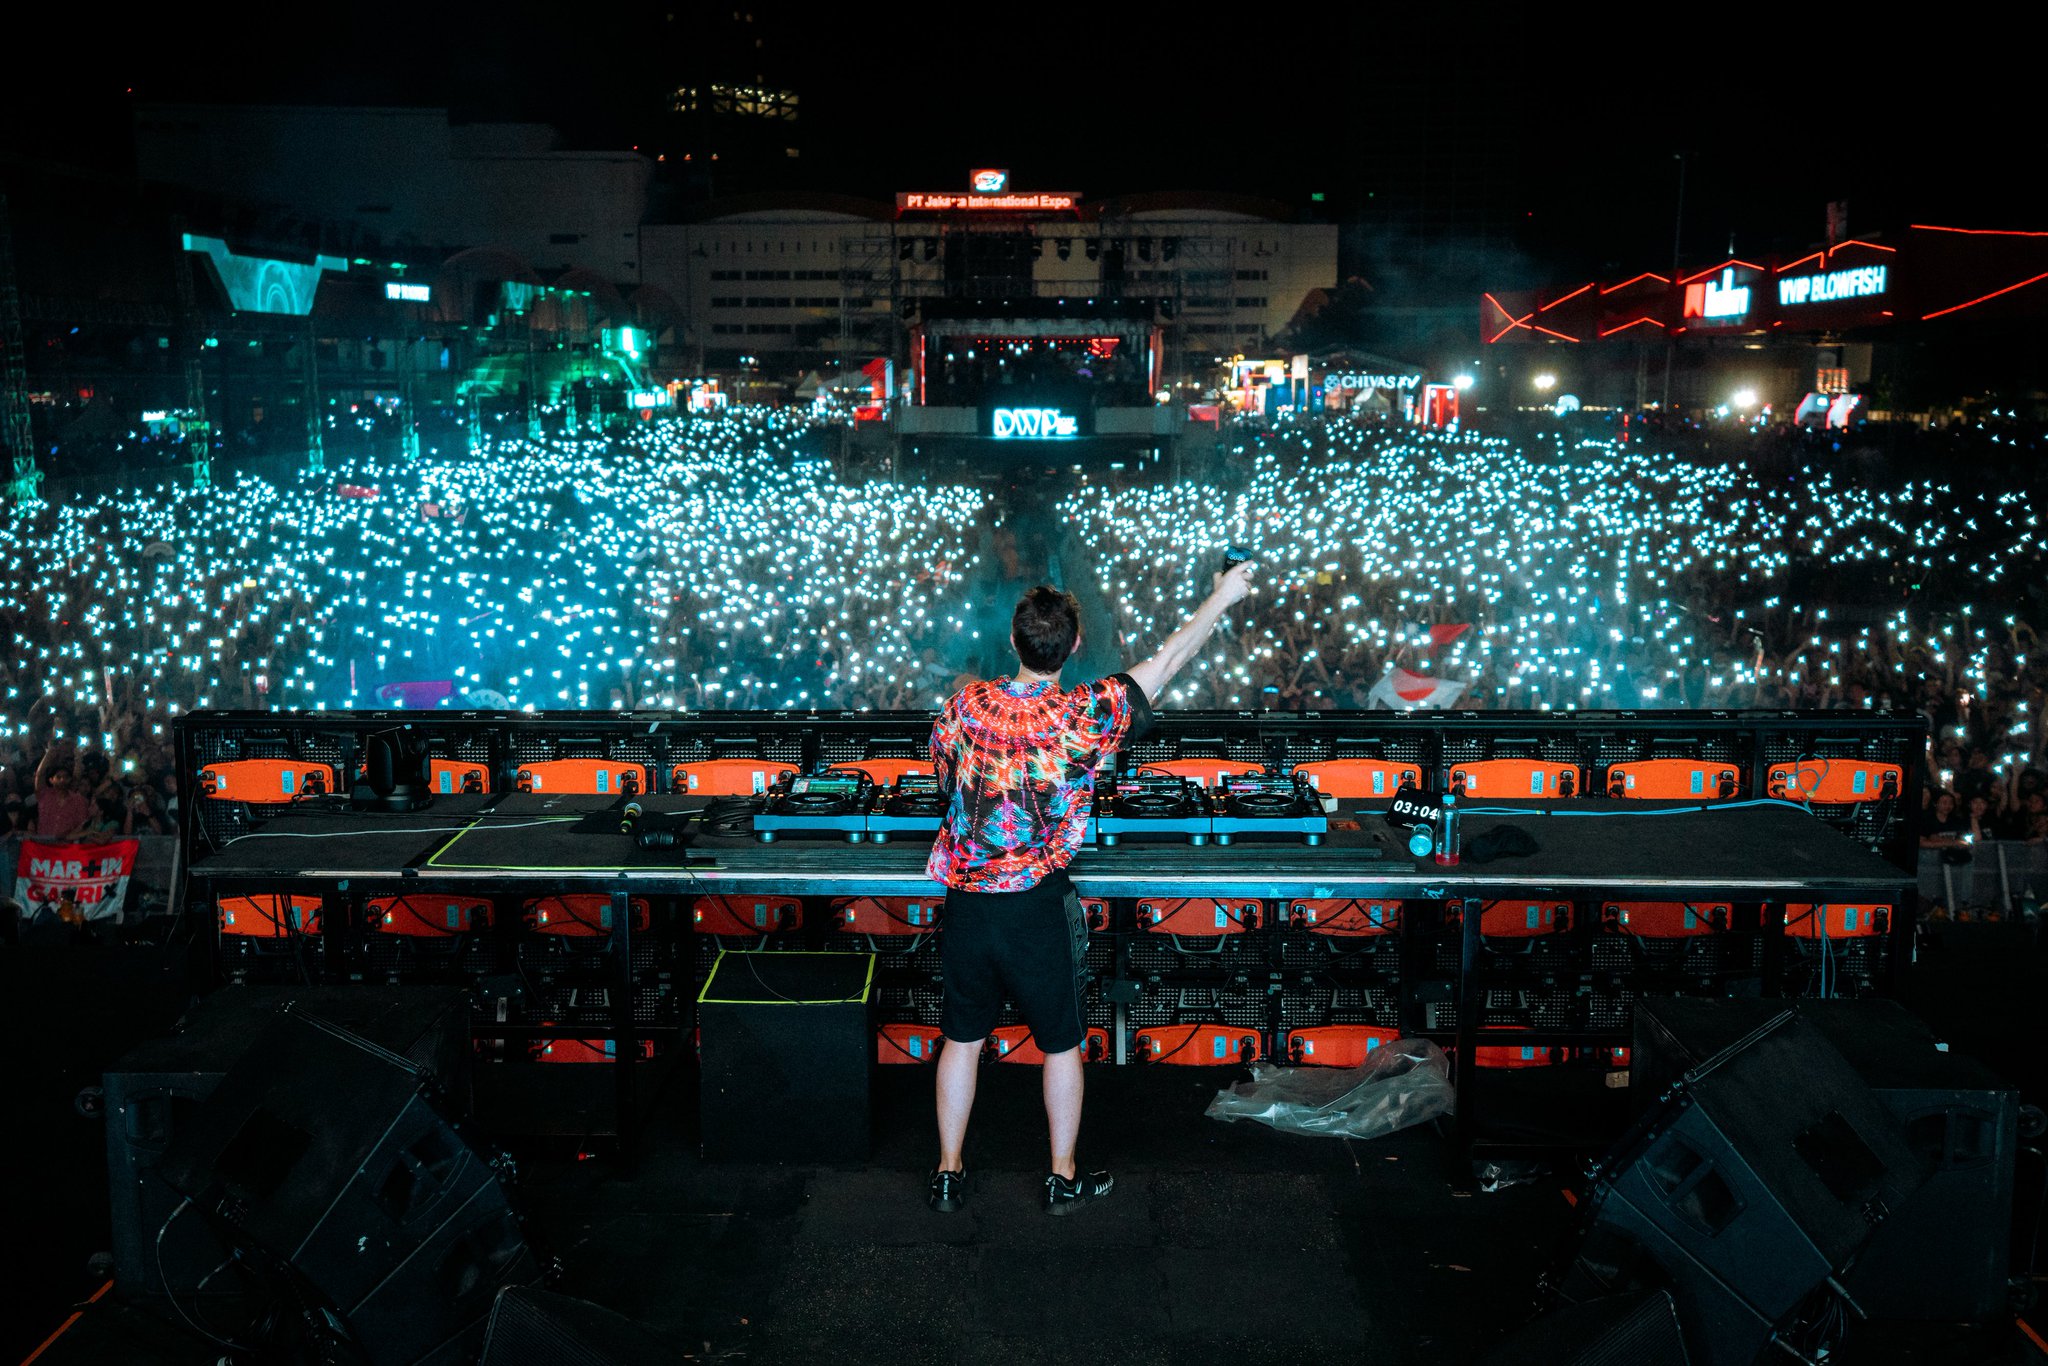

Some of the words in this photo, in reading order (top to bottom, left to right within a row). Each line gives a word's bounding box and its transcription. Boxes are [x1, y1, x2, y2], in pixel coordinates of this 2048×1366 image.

[907, 194, 923, 208] PT
[967, 194, 1038, 208] International
[1039, 194, 1071, 210] Expo
[1810, 265, 1886, 302] BLOWFISH
[1340, 374, 1396, 390] CHIVAS
[1393, 799, 1438, 820] 03:04
